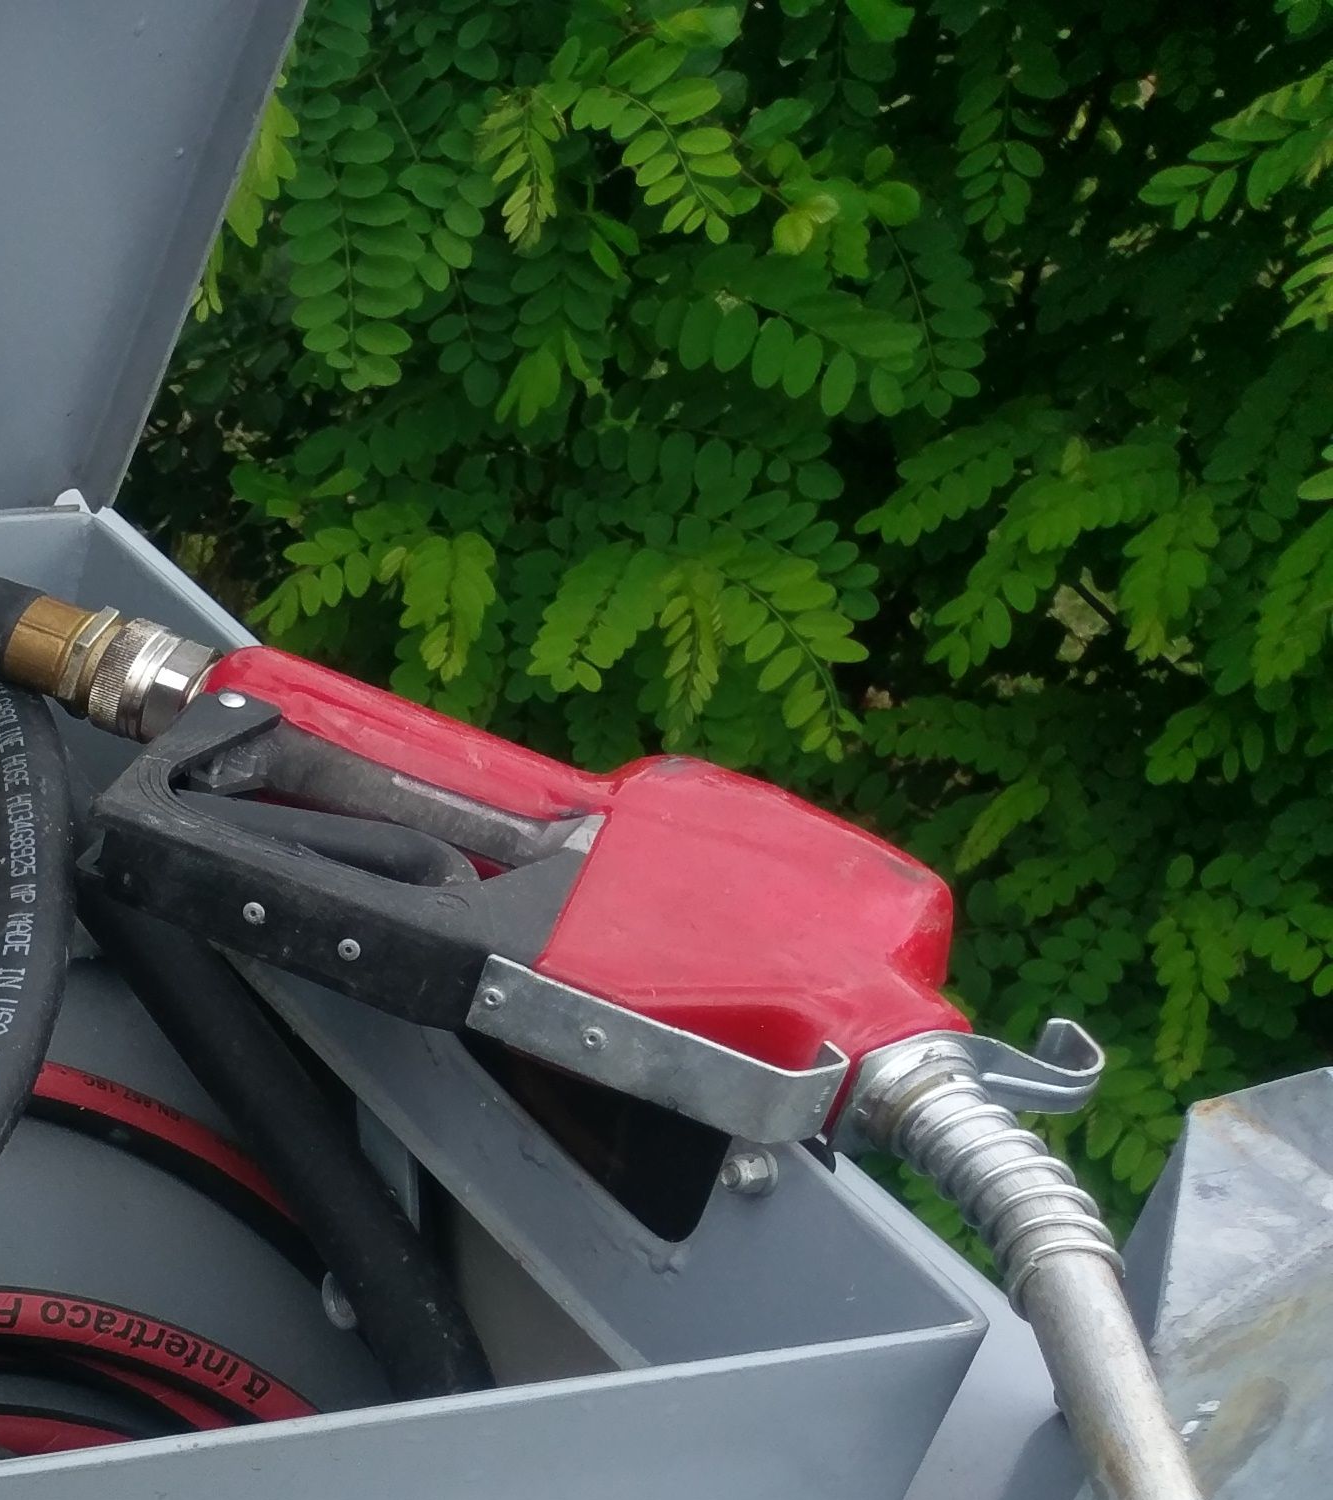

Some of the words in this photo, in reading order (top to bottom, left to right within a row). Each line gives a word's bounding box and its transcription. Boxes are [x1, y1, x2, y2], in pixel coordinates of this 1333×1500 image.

[1, 753, 30, 792] HOSE
[10, 883, 36, 904] MP
[3, 912, 35, 956] MADE
[41, 1299, 242, 1390] intertraco
